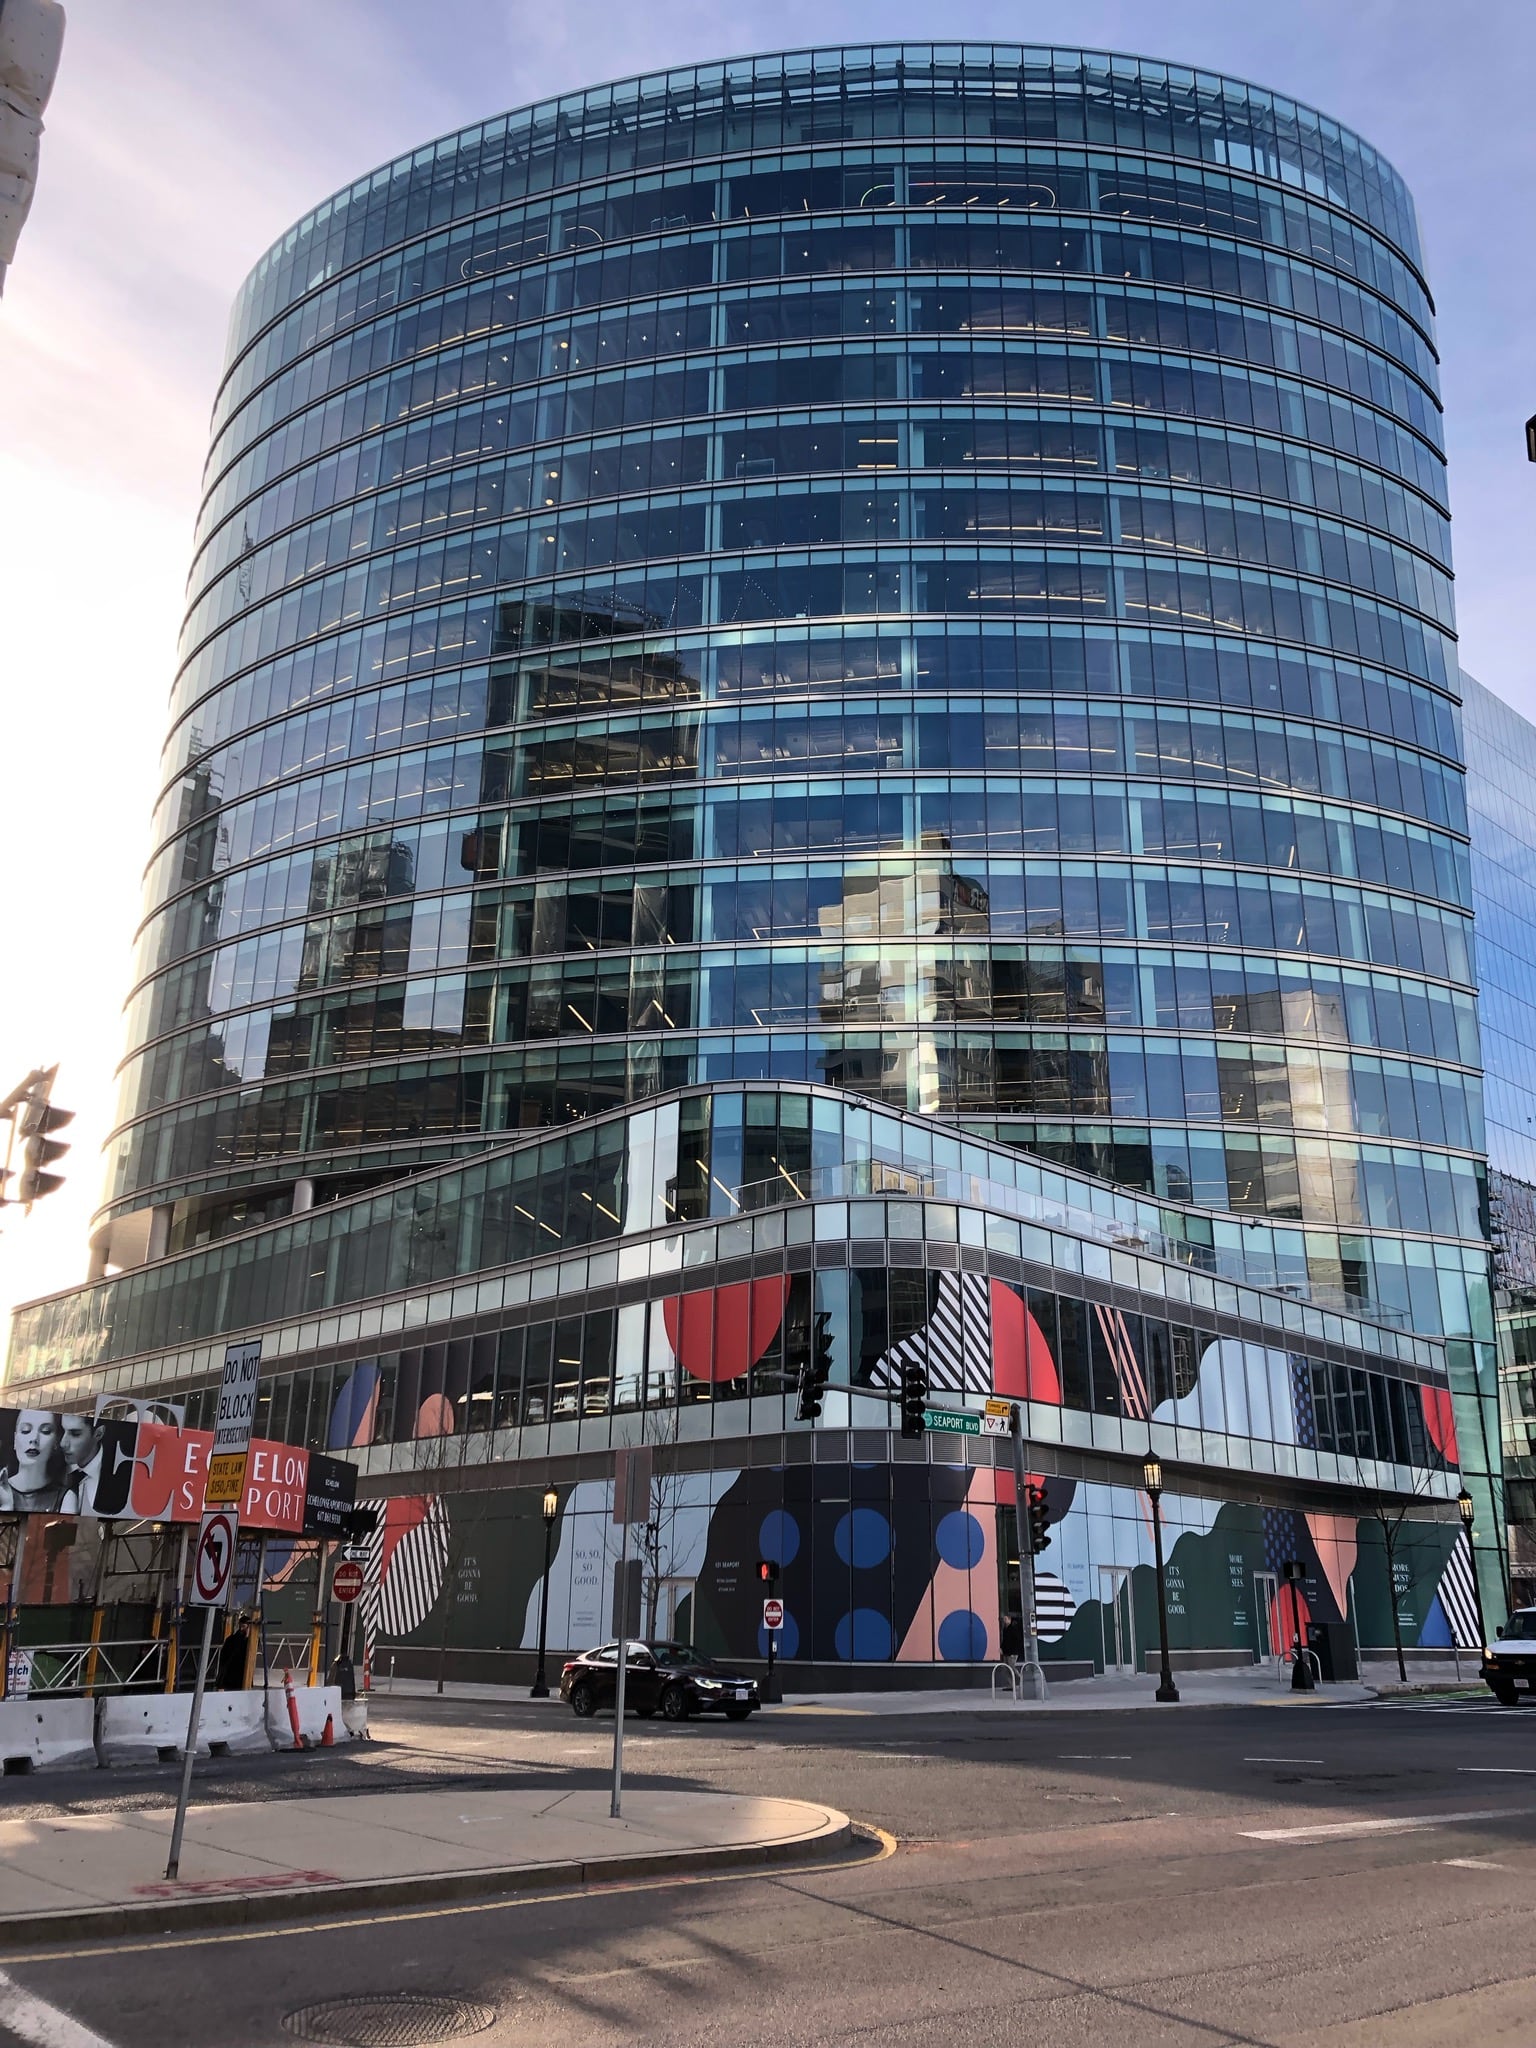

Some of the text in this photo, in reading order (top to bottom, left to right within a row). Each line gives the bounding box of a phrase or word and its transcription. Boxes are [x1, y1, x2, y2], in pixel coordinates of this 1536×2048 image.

[224, 1356, 260, 1385] DO NOT
[219, 1393, 254, 1420] BLOCK
[933, 1415, 979, 1431] SEAPORT BLVD
[184, 1443, 306, 1489] EELON
[213, 1461, 243, 1476] STATE LAW
[180, 1481, 303, 1521] SPORT
[582, 1563, 593, 1572] SO
[464, 1581, 472, 1590] BE
[1165, 1579, 1185, 1589] GONNA
[1172, 1591, 1181, 1601] BE
